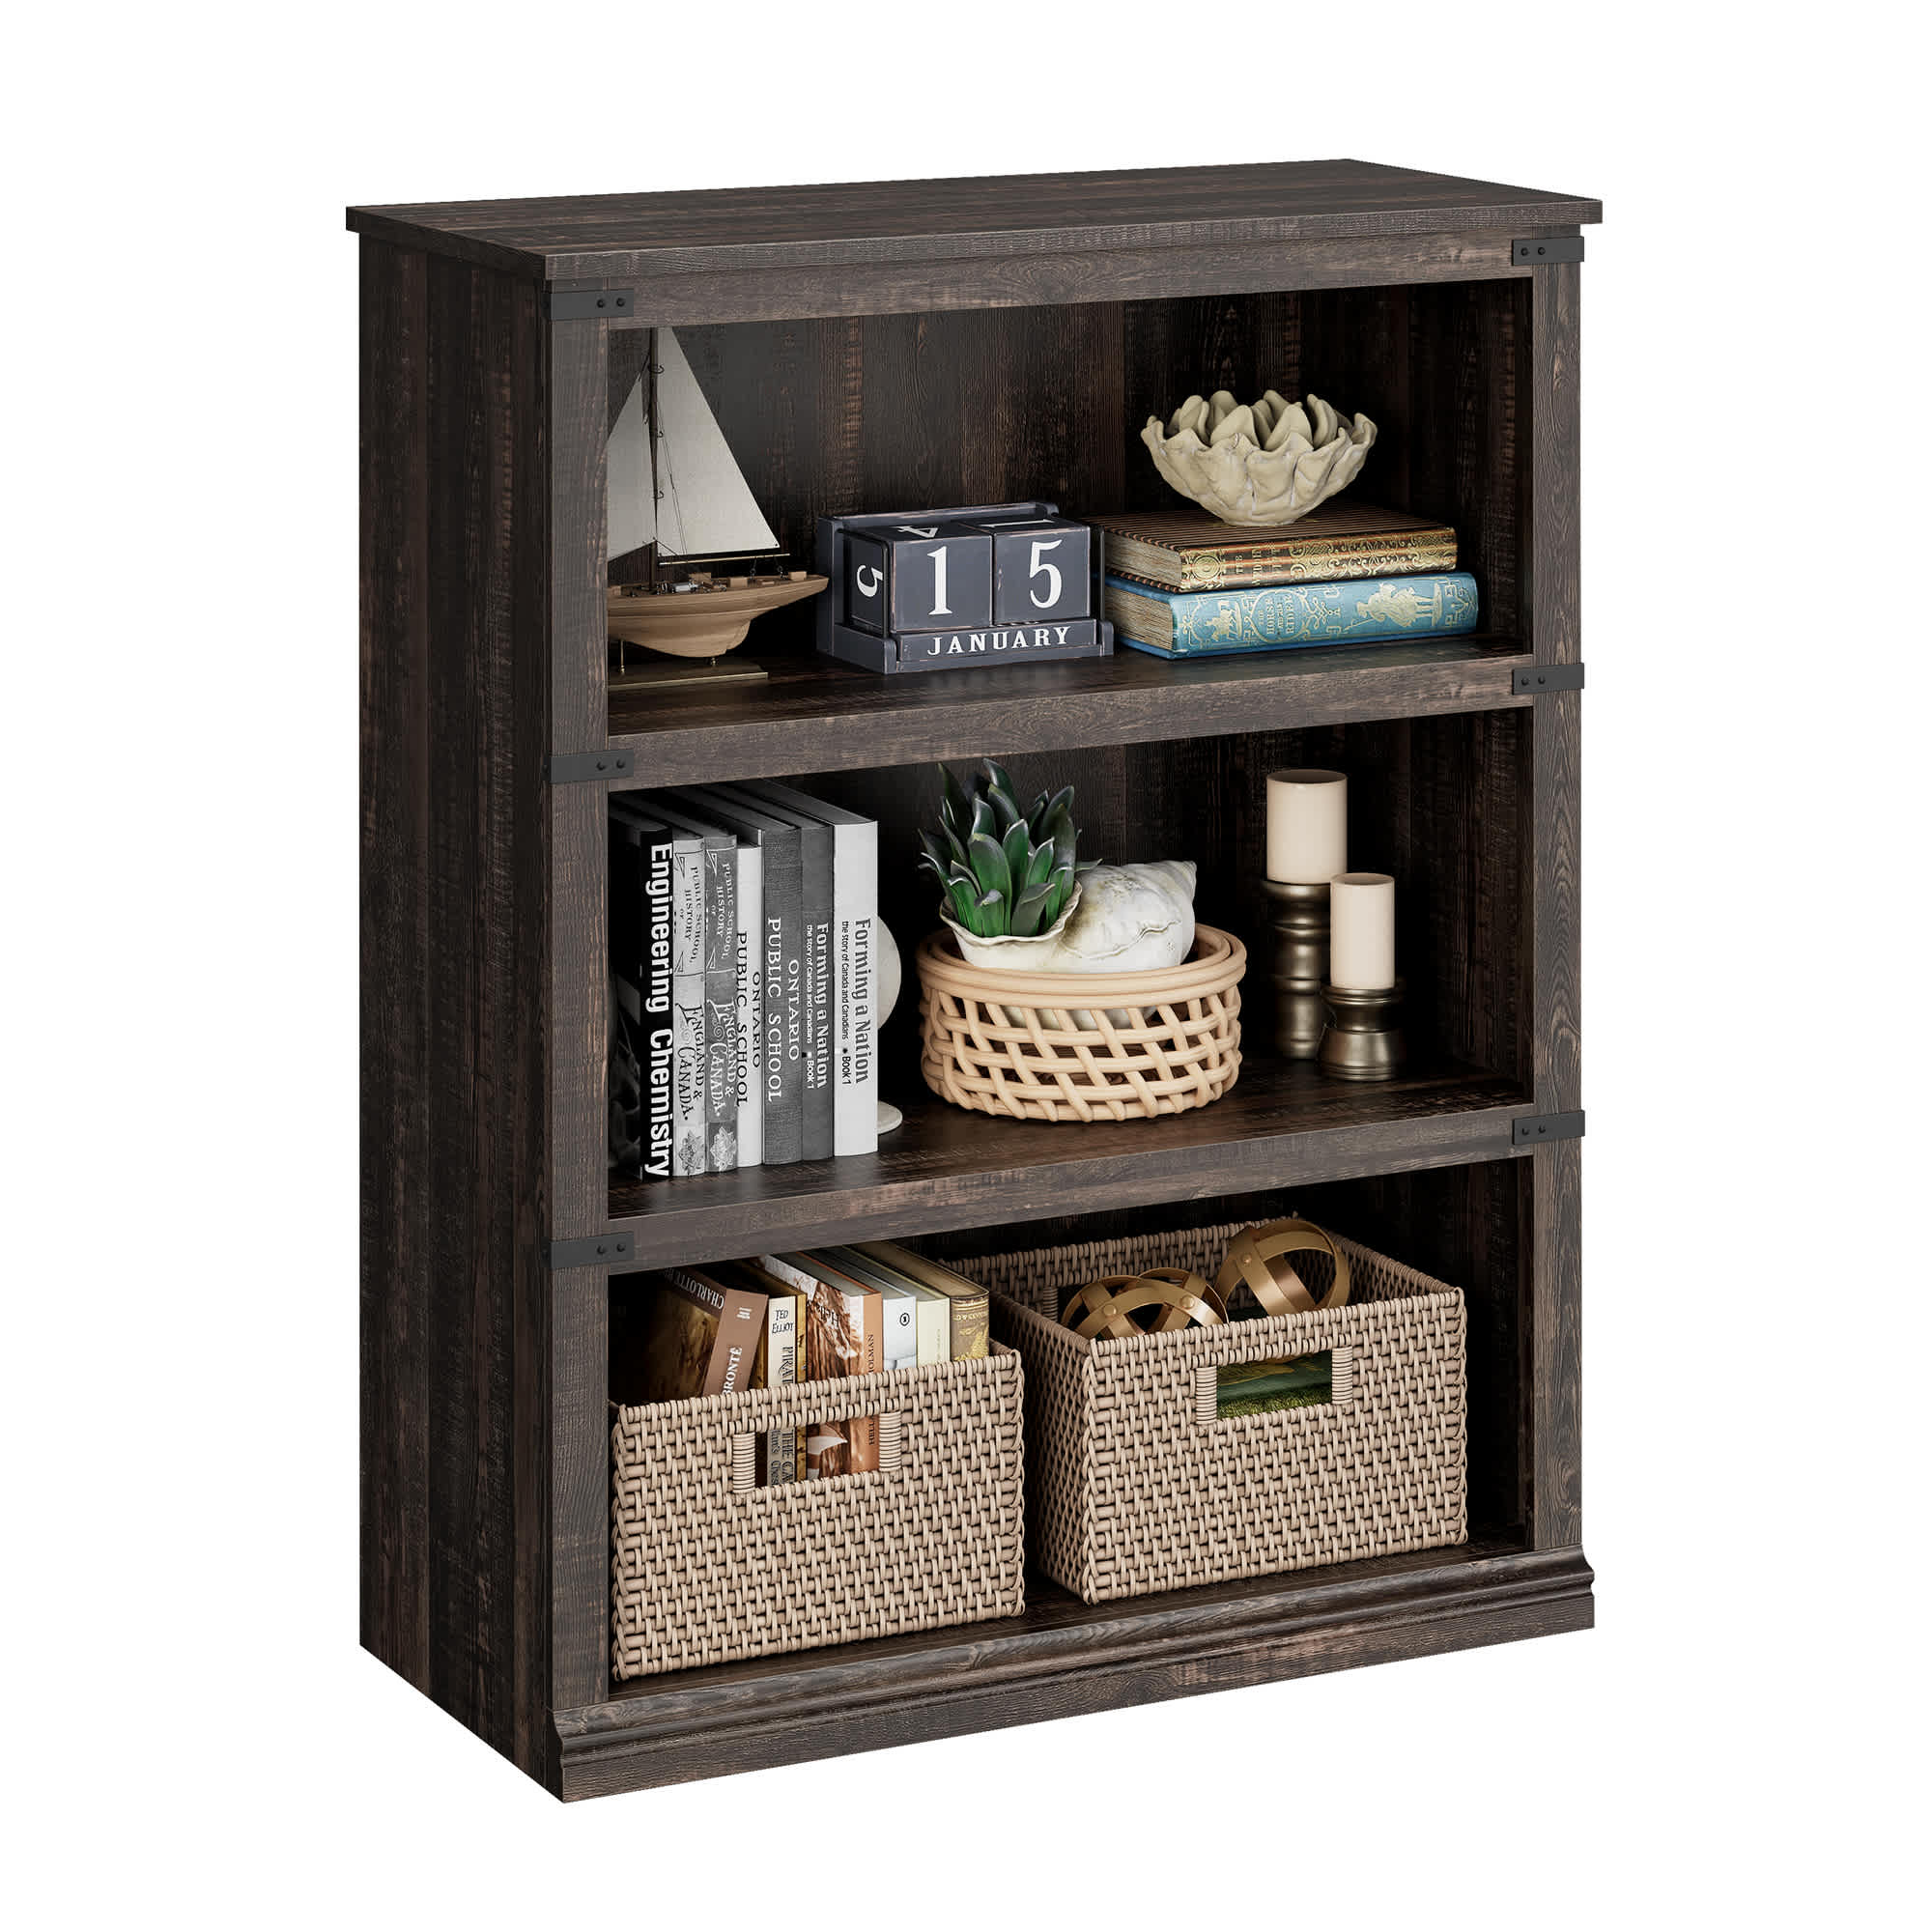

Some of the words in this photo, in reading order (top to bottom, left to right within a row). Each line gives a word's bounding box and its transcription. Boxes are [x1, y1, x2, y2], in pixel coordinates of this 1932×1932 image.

[857, 564, 883, 597] 5
[927, 546, 952, 615] 1
[1030, 539, 1062, 609] 5
[927, 626, 1071, 656] JANUARY
[644, 842, 673, 1012] Engineering
[685, 889, 694, 941] HISTORY
[717, 886, 725, 938] HISTORY
[722, 911, 734, 959] SCHOOL
[689, 914, 701, 963] SCHOOL
[768, 918, 781, 998] PUBLIC
[806, 957, 813, 966] of
[814, 922, 830, 1004] Forming
[852, 918, 871, 1000] Forming
[737, 932, 748, 1008] PUBLIC
[841, 962, 850, 988] Canada
[752, 971, 761, 1068] ONTARIO
[787, 958, 800, 1062] ONTARIO
[816, 1009, 827, 1021] a
[841, 989, 850, 1004] and
[841, 1004, 850, 1040] Canadians
[855, 1005, 868, 1016] a
[675, 1003, 704, 1086] ENGLAND
[706, 999, 736, 1083] ENGLAND
[737, 1022, 748, 1107] SCHOOL
[768, 1012, 781, 1102] SCHOOL
[816, 1024, 830, 1088] Nation
[841, 1056, 852, 1078] Book
[855, 1019, 871, 1084] Nation
[807, 1060, 815, 1083] Book
[644, 1029, 673, 1177] Chemistry
[776, 1309, 789, 1321] TED
[779, 1346, 794, 1383] PIRAT
[781, 1430, 793, 1460] THE
